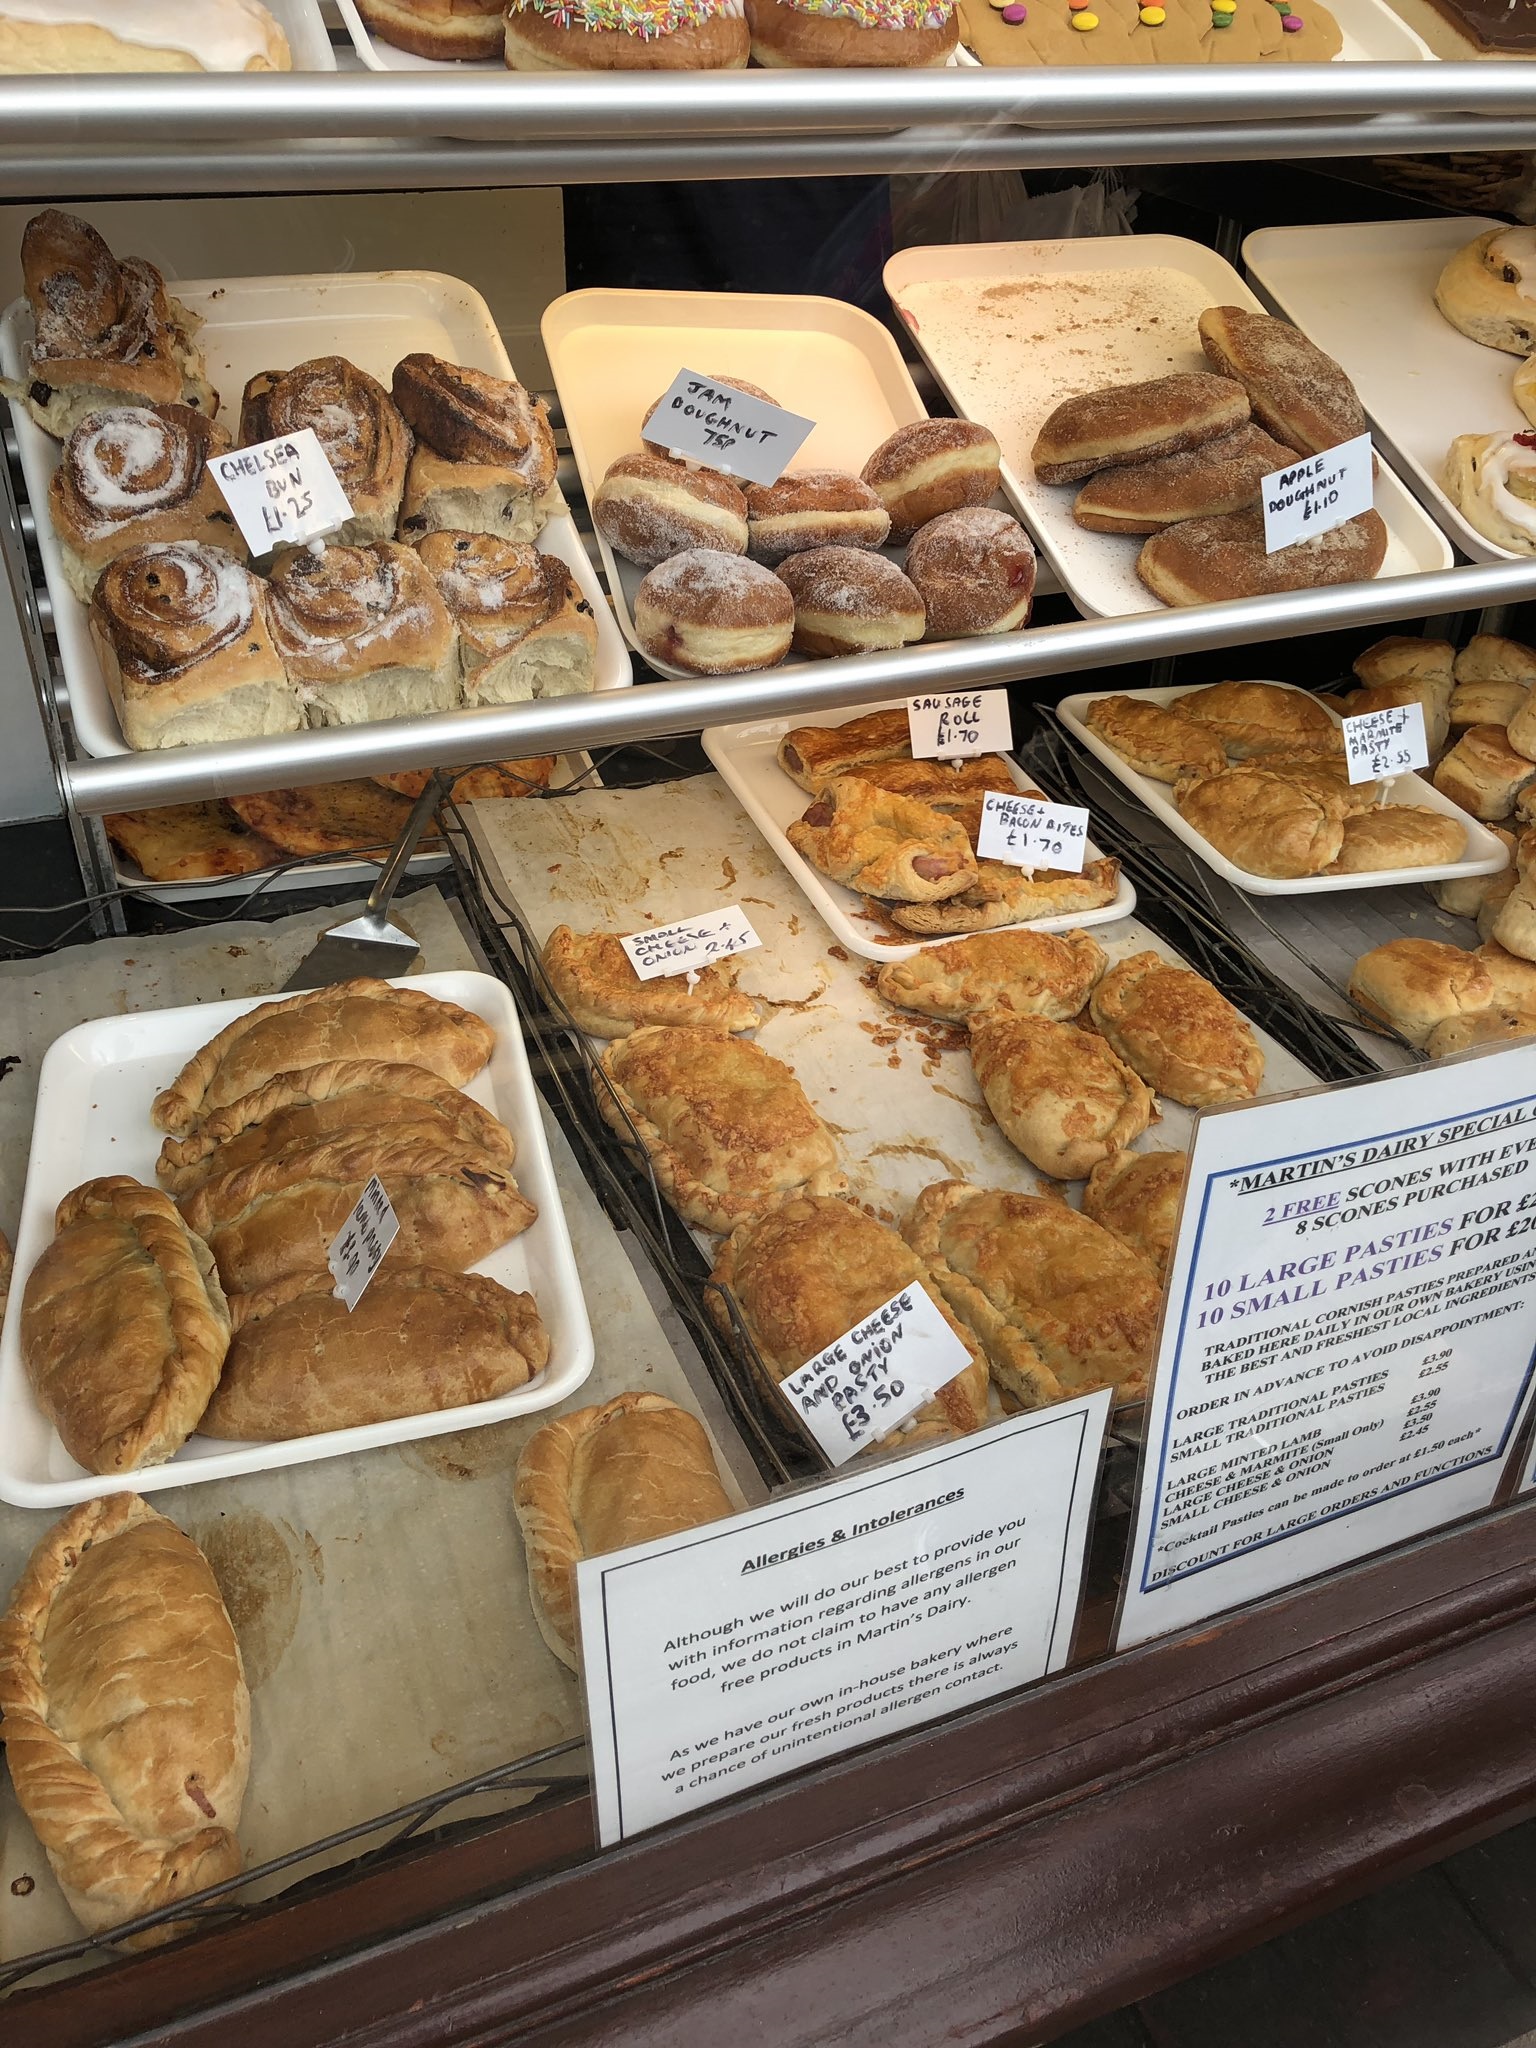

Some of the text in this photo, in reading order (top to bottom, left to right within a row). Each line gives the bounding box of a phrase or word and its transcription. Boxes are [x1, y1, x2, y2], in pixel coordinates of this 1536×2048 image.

[671, 396, 778, 443] DOUGHNUT
[687, 381, 732, 411] JAM
[220, 443, 300, 482] CHELSEA
[265, 467, 302, 498] BUN
[1268, 467, 1347, 513] DOUGHNUT
[1279, 458, 1324, 490] APPLE
[912, 695, 982, 711] SAUSAGE
[940, 711, 980, 727] ROLL
[1346, 709, 1393, 733] CHEESE
[1349, 722, 1403, 746] MARMITE
[1352, 738, 1390, 759] PASTY
[1372, 749, 1411, 773] £2.55
[1000, 813, 1084, 837] BACON BITES
[1006, 828, 1063, 854] £1.70
[1362, 1131, 1439, 1164] DAIRY
[1437, 1107, 1527, 1144] SPECIAL
[1281, 1191, 1342, 1220] FREE
[1345, 1167, 1433, 1203] SCONES
[1439, 1149, 1496, 1177] WITH
[1311, 1159, 1529, 1231] SCONES PURCHASED
[1196, 1306, 1224, 1329] 10
[1230, 1279, 1327, 1319] SMALL
[1334, 1244, 1443, 1290] PASTIES
[1447, 1226, 1501, 1257] FOR
[1203, 1279, 1231, 1301] 10
[1237, 1250, 1337, 1292] LARGE
[1342, 1217, 1454, 1264] PASTIES
[1457, 1200, 1511, 1230] FOR
[1200, 1348, 1255, 1372] BAKED
[1258, 1334, 1300, 1354] HERE
[1303, 1318, 1351, 1341] DAILY
[1372, 1303, 1404, 1319] OUR
[1407, 1290, 1443, 1309] OWN
[1444, 1270, 1503, 1297] BAKERY
[1204, 1253, 1520, 1356] TRADITIONAL CORNISH PASTIES PREPARED
[788, 1292, 914, 1395] LARGE CHEESE
[1176, 1300, 1524, 1420] ORDER ADVANCE AVOID DISAPPOINTMENT:
[1204, 1366, 1236, 1384] THE
[1239, 1353, 1278, 1374] BEST
[1280, 1344, 1313, 1361] AND
[1315, 1319, 1391, 1350] FRESHEST
[1392, 1304, 1441, 1326] LOCAL
[801, 1374, 838, 1415] AND
[832, 1356, 889, 1412] PASTY
[842, 1379, 905, 1442] £3.50
[1172, 1423, 1224, 1449] LARGE
[1227, 1390, 1328, 1430] TRADITIONAL
[1331, 1369, 1389, 1396] PASTIES
[1170, 1438, 1221, 1463] SMALL
[1225, 1403, 1325, 1443] TRADITIONAL
[1327, 1382, 1385, 1409] PASTIES
[1160, 1504, 1209, 1530] SMALL
[1213, 1482, 1268, 1509] CHEESE
[1285, 1459, 1331, 1482] ONION
[1163, 1491, 1212, 1517] LARGE
[1215, 1469, 1271, 1496] CHEESE
[1288, 1446, 1334, 1469] ONION
[1164, 1475, 1221, 1503] CHEESE
[1240, 1444, 1309, 1476] MARMITE
[1311, 1429, 1349, 1451] (Small
[1351, 1418, 1384, 1435] Only)
[1167, 1464, 1217, 1490] LARGE
[1220, 1444, 1277, 1471] MINTED
[1280, 1428, 1322, 1450] LAMB
[1221, 1508, 1264, 1530] Pasties
[1267, 1499, 1289, 1512] can
[1310, 1478, 1344, 1496] made
[1362, 1459, 1396, 1477] order
[741, 1487, 964, 1571] Allergies Intolerances
[1152, 1445, 1492, 1581] DISCOUNT FOR LARGE ORDERS AND FUNCTIONS
[663, 1517, 1025, 1653] Although will our best provide you
[668, 1537, 1021, 1671] with information regarding allergens our
[670, 1559, 1016, 1690] food, not claim have any allergen
[720, 1596, 971, 1693] free products Martin's Dairy.
[691, 1640, 1018, 1772] prepare our fresh products there always
[724, 1626, 1012, 1740] have our own in-house bakery where
[689, 1663, 1003, 1787] chance unintentional allergen contact.
